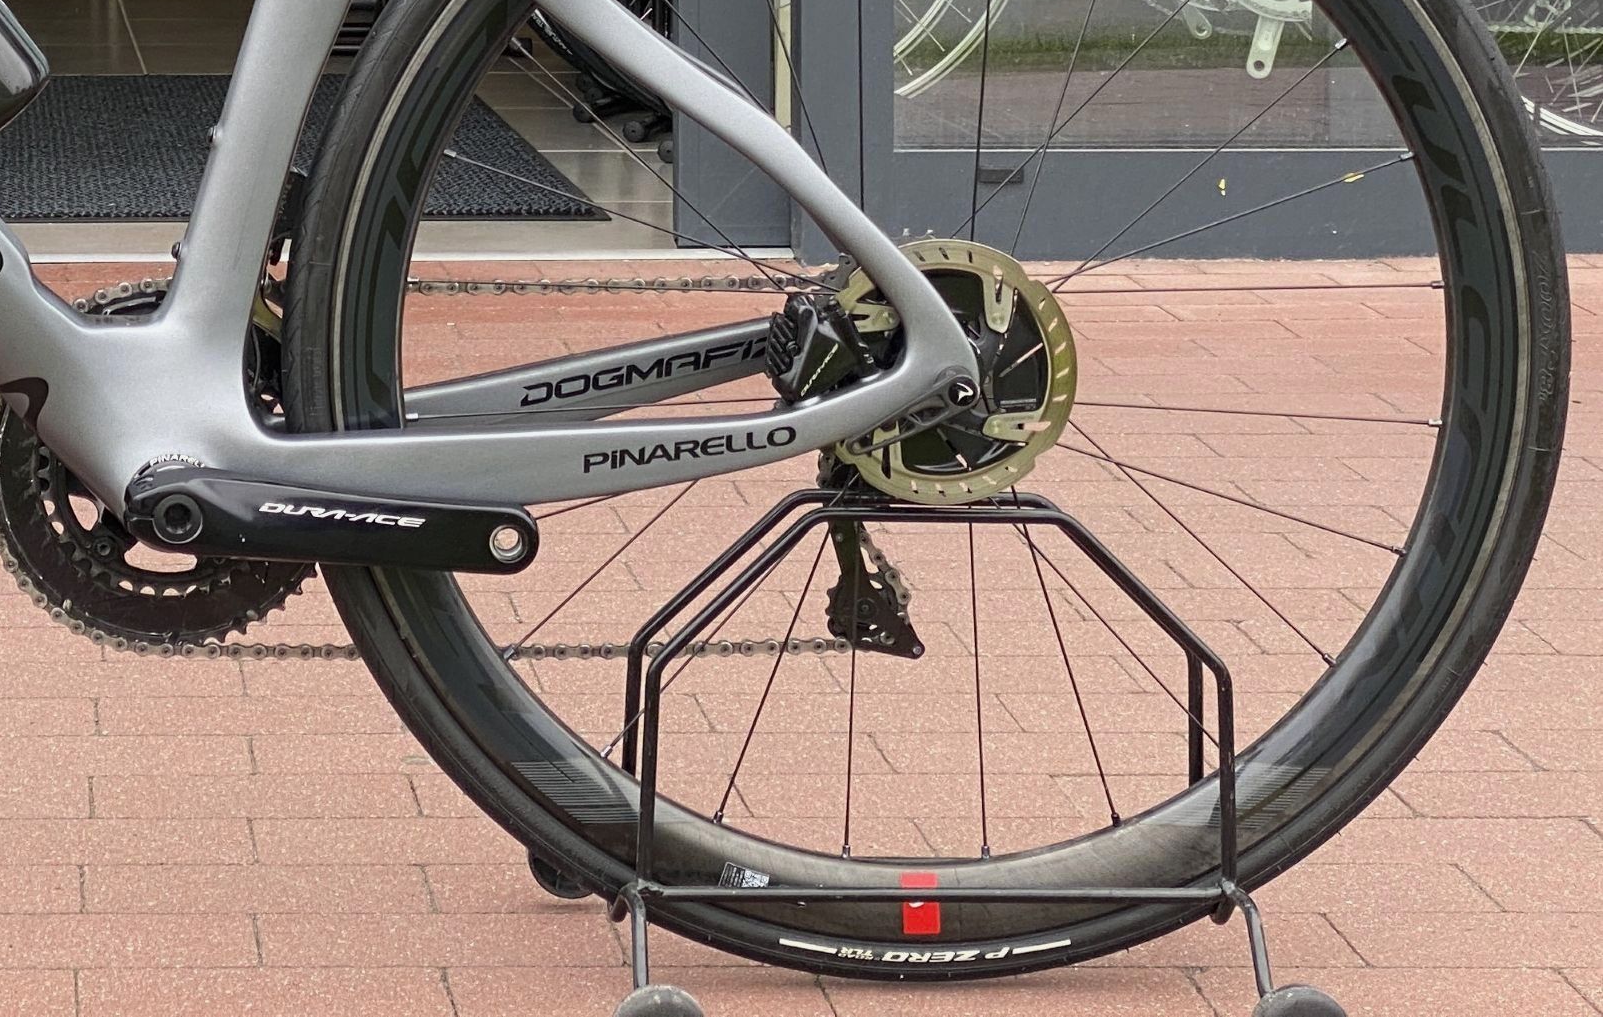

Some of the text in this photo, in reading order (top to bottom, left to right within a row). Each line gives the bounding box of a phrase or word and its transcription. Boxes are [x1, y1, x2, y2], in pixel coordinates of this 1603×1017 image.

[583, 426, 797, 474] PINARELLO
[259, 502, 426, 528] DURA-ACE
[881, 949, 981, 963] ZERO
[984, 947, 1011, 960] P
